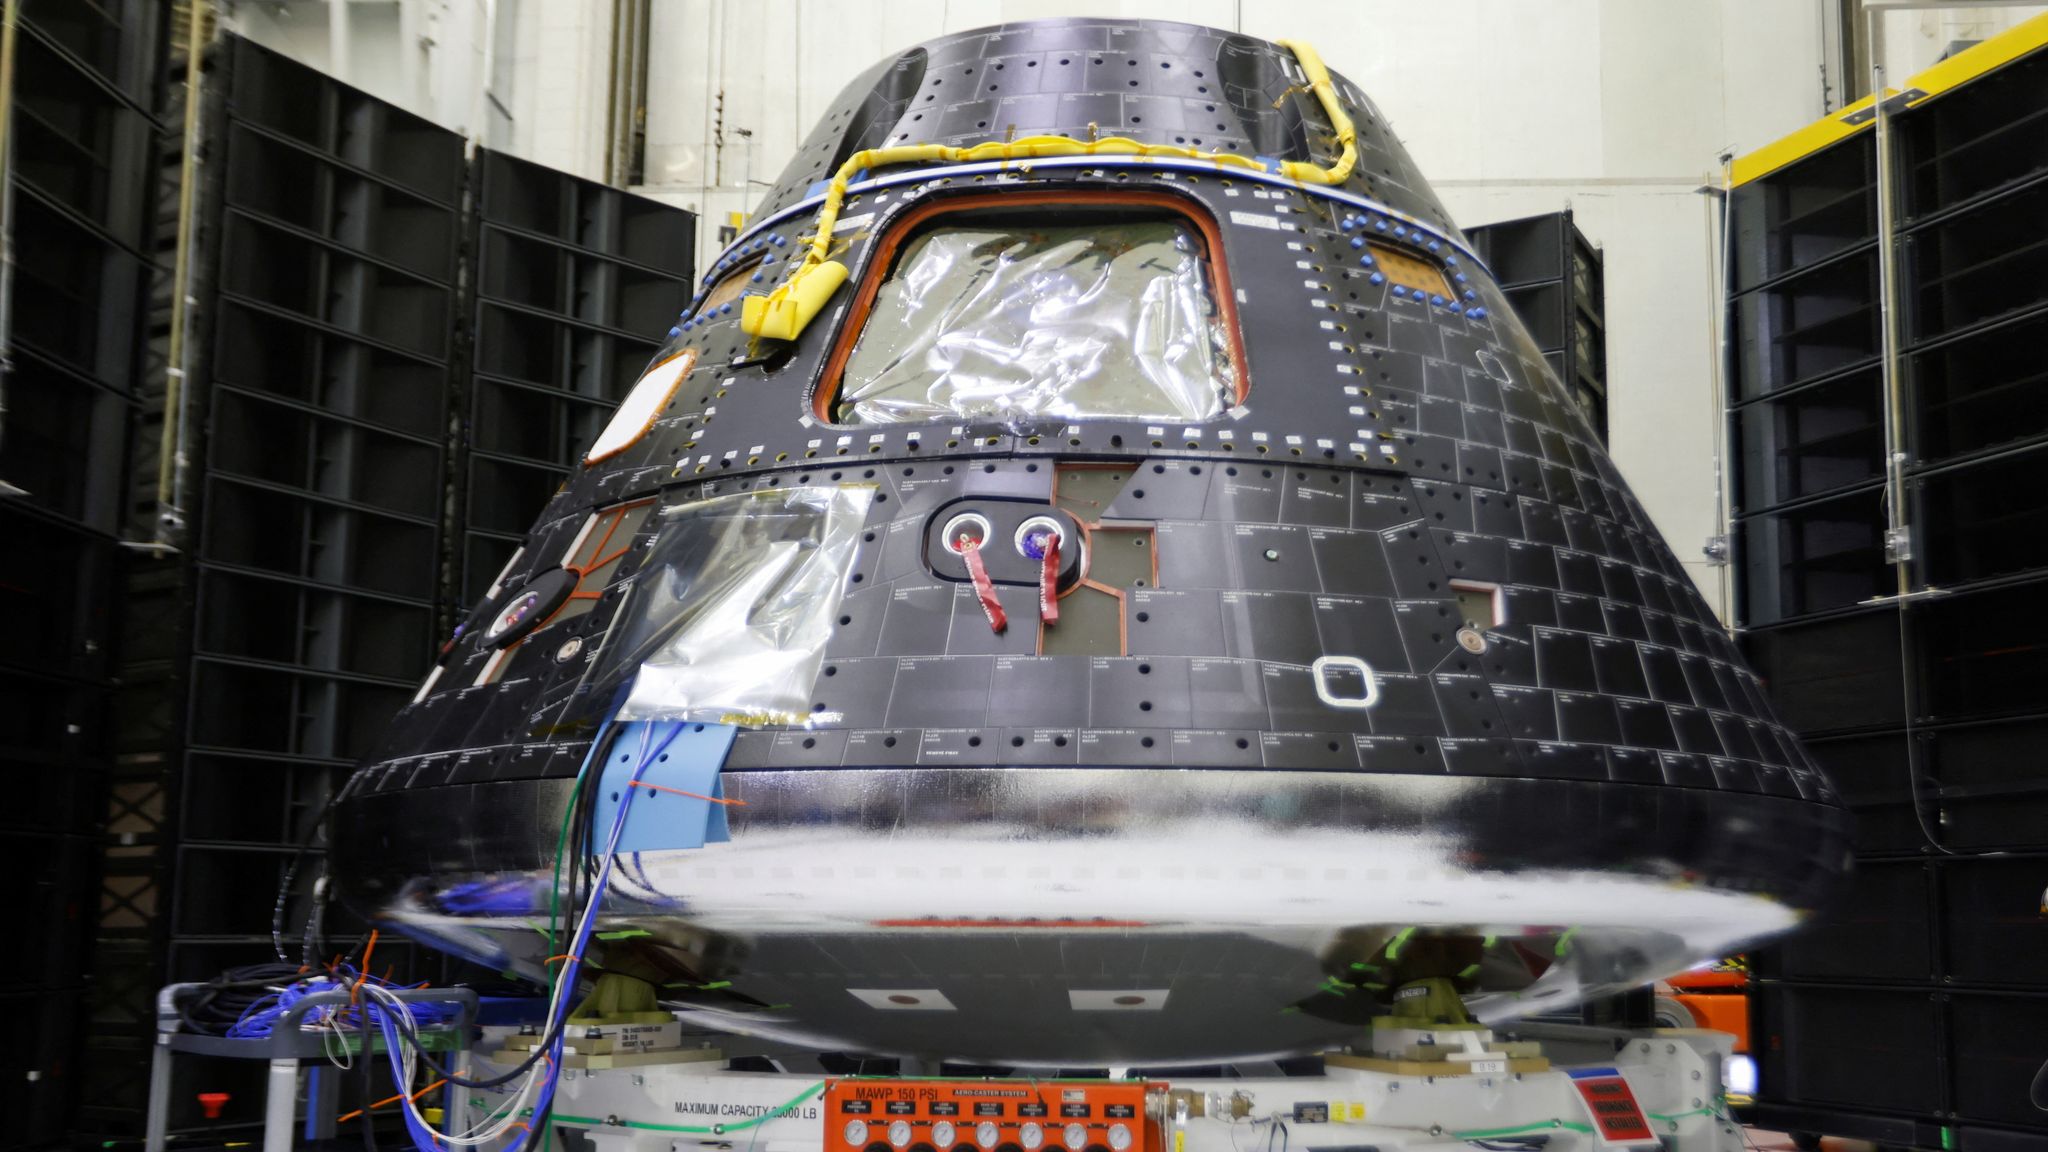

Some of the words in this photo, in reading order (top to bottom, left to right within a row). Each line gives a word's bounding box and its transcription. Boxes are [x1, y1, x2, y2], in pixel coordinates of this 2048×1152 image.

[855, 1087, 893, 1100] MAWP
[897, 1088, 916, 1100] 150
[919, 1088, 938, 1101] PSI
[674, 1101, 719, 1115] MAXIMUM
[721, 1104, 768, 1118] CAPACITY
[771, 1106, 800, 1118] 000
[803, 1107, 817, 1119] LB
